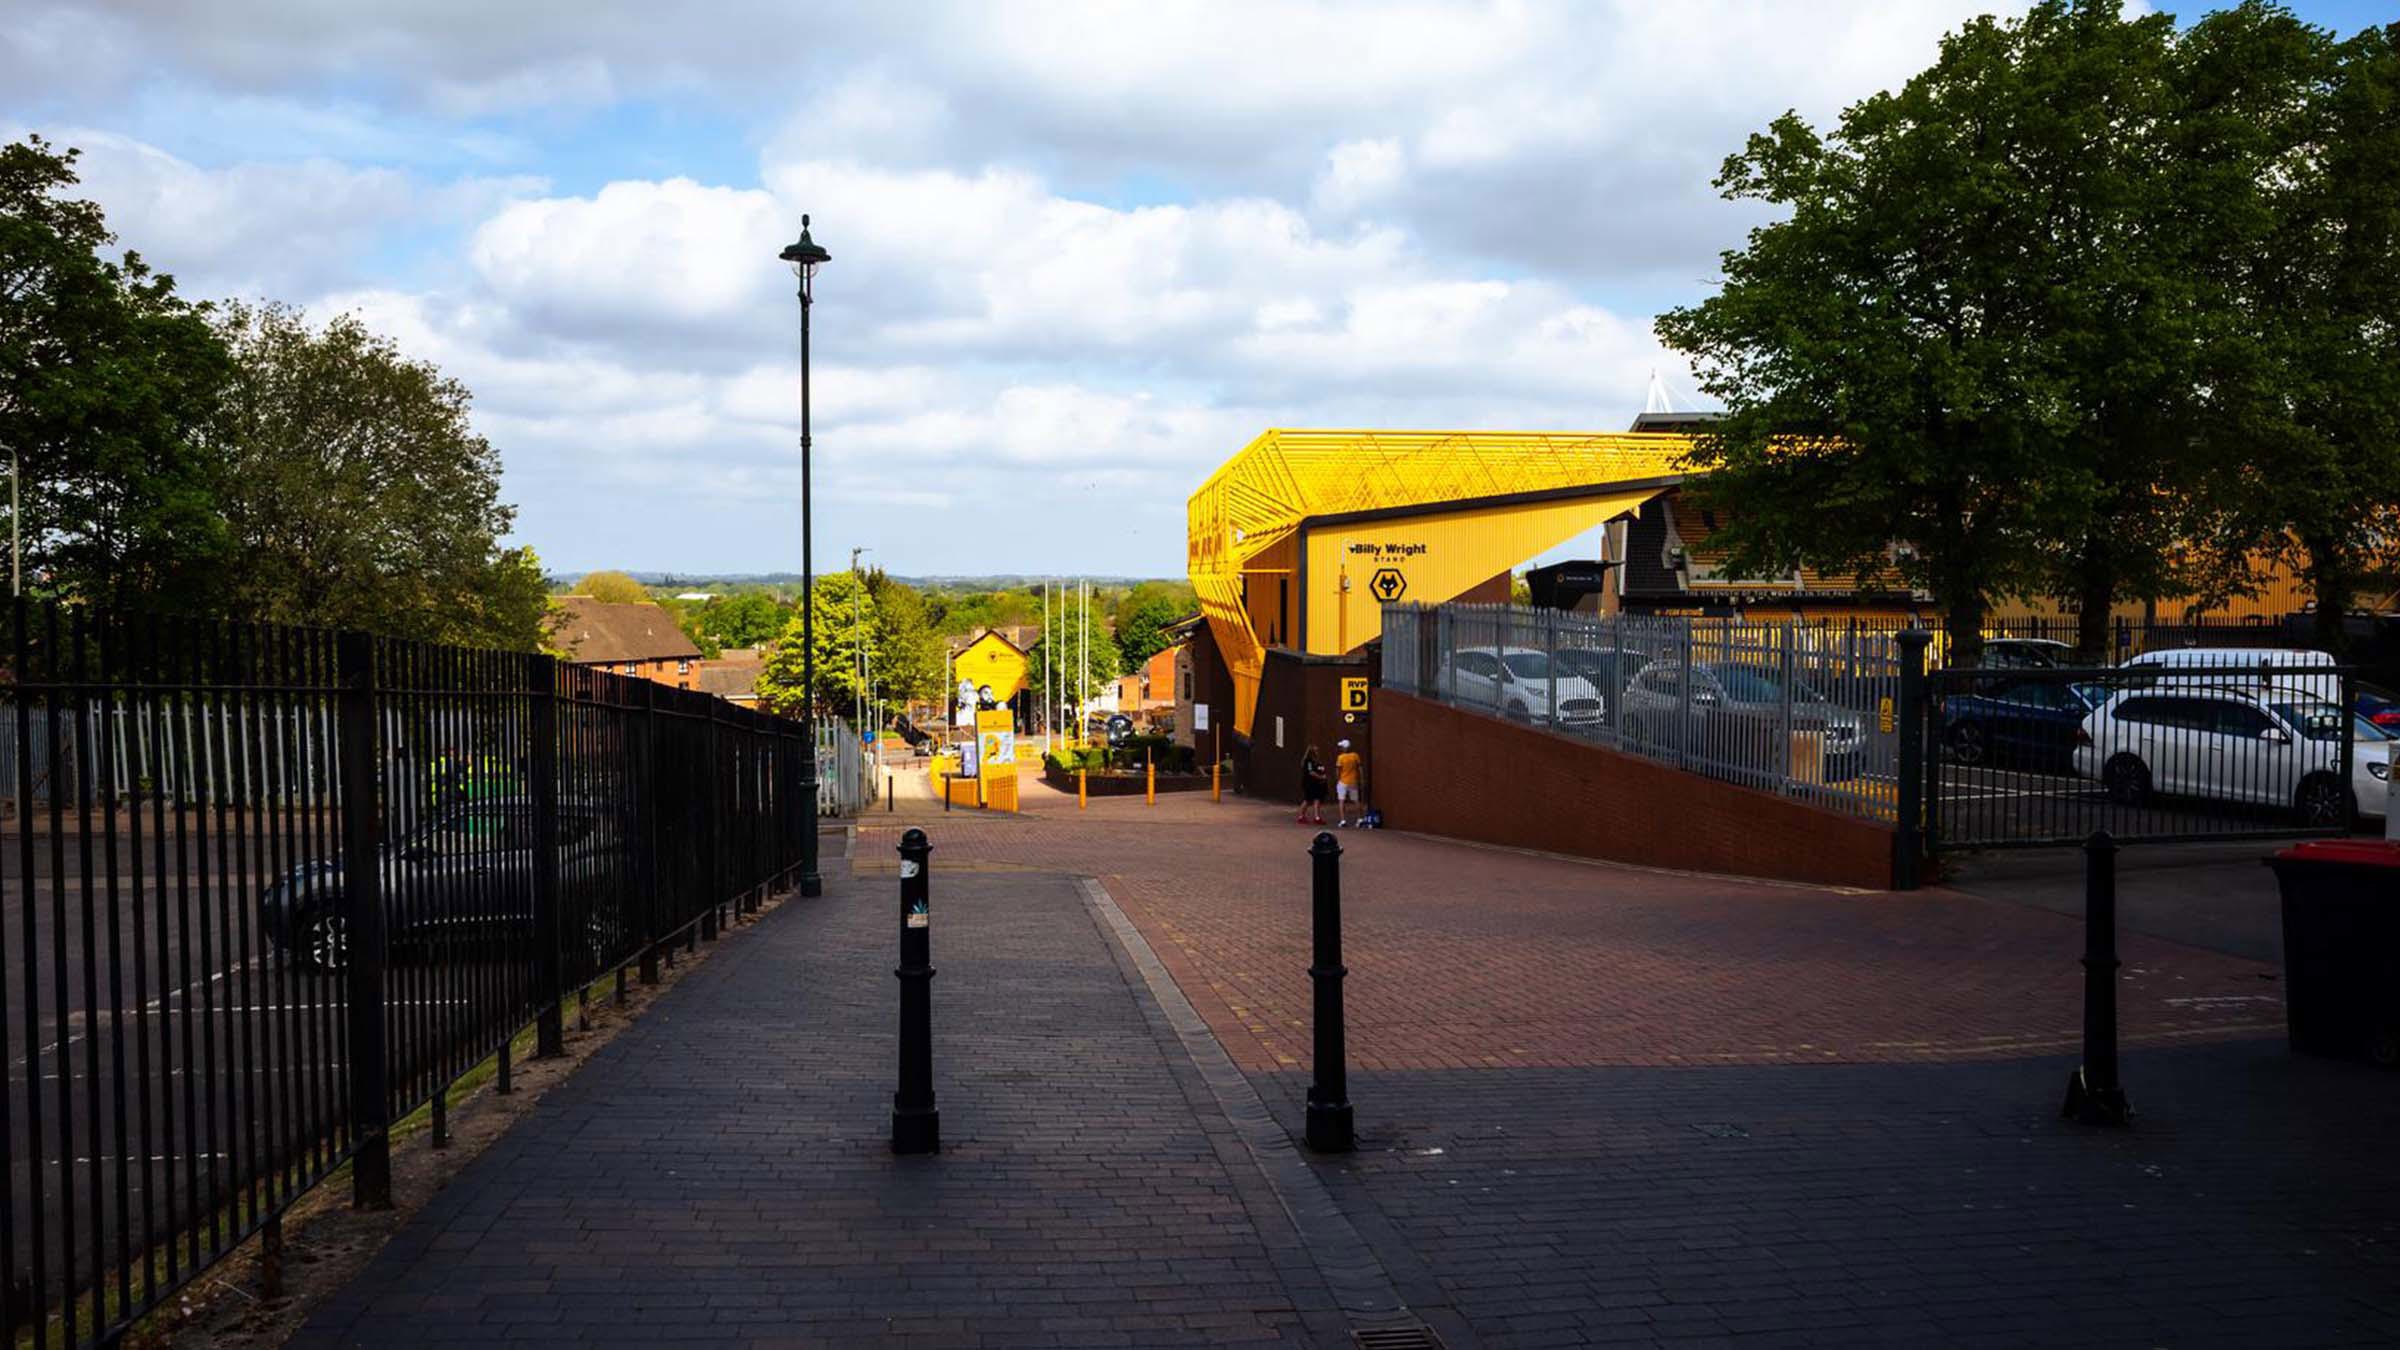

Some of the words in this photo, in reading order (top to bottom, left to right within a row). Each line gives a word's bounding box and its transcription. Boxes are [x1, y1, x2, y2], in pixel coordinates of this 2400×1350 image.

[1355, 544, 1382, 556] Billy
[1385, 544, 1427, 556] Wright
[1347, 680, 1367, 688] RVP
[1350, 690, 1366, 707] D
